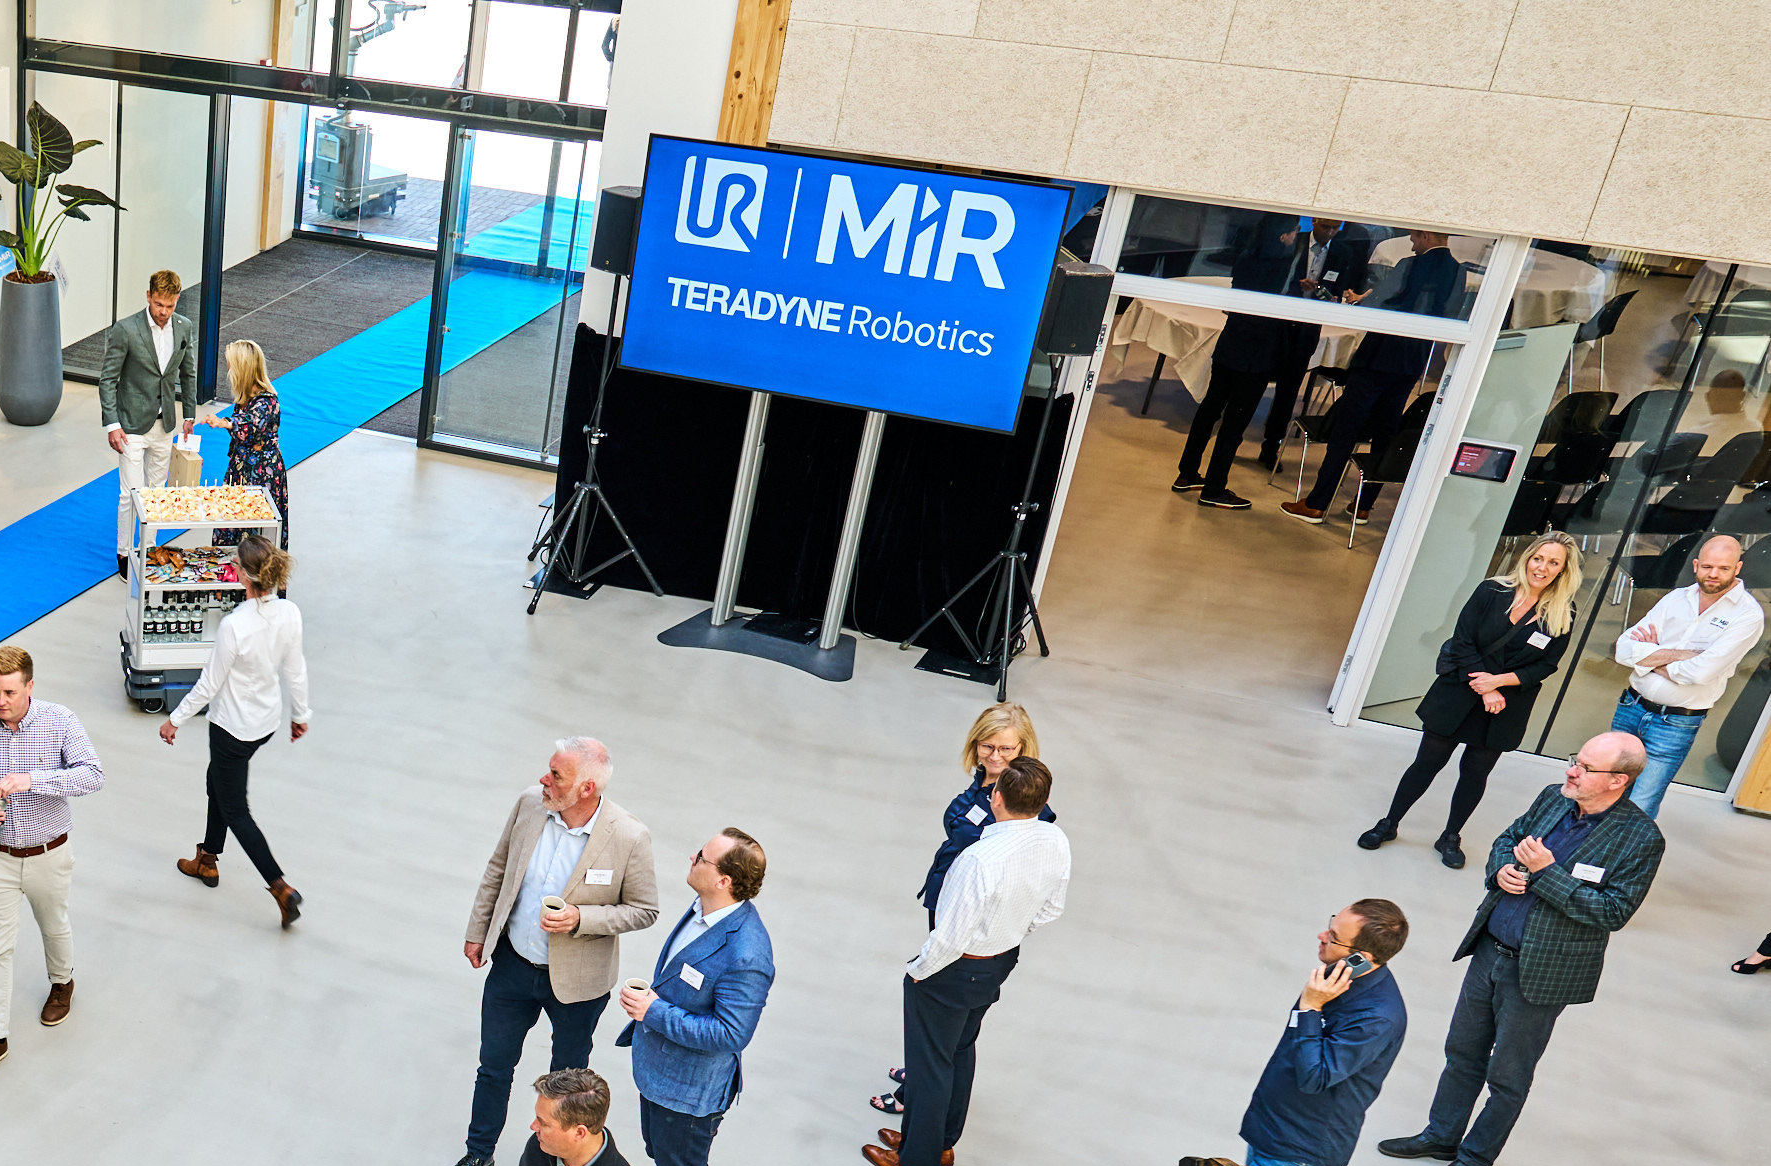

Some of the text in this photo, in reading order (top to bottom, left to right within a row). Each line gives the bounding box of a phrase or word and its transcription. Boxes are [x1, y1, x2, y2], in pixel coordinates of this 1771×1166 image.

[815, 173, 1017, 290] MiR
[667, 276, 995, 357] TERADYNE Robotics
